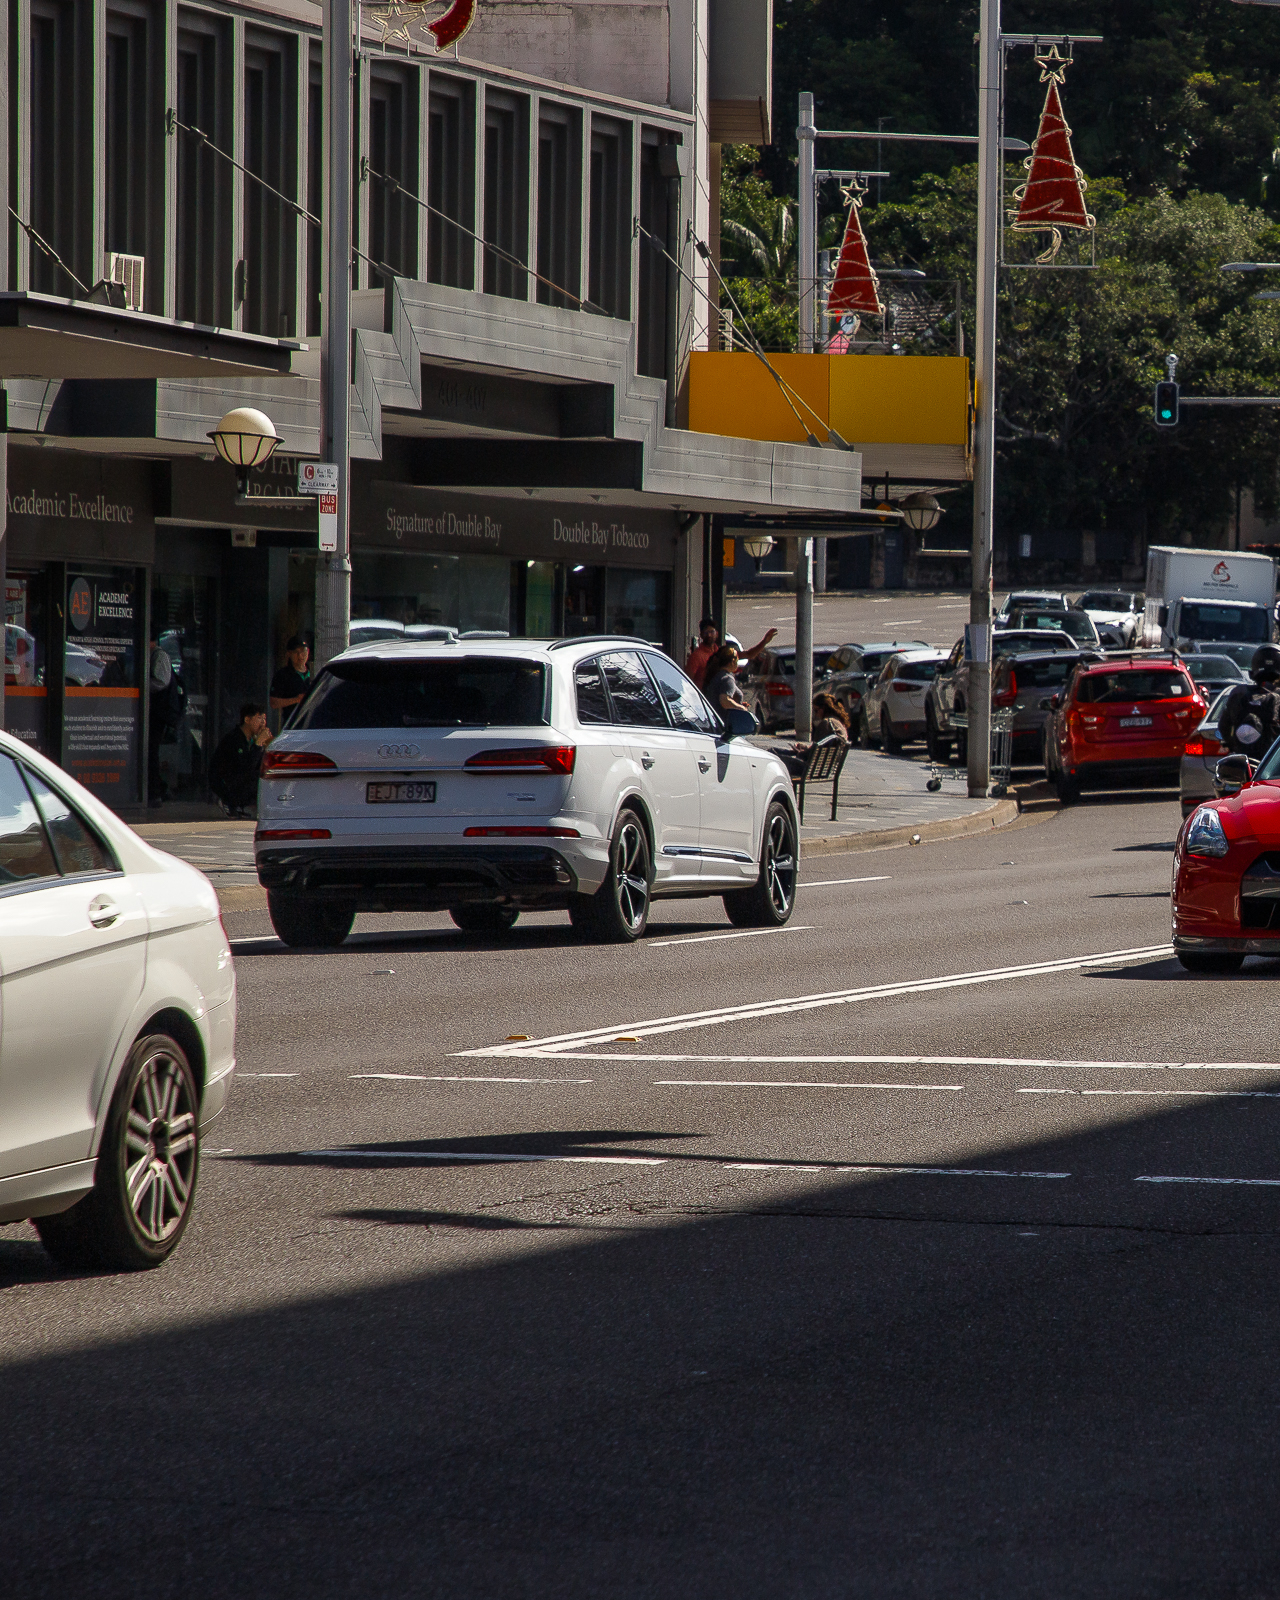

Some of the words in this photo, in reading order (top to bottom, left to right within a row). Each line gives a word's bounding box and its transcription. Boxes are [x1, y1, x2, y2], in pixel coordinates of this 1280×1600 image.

[69, 493, 134, 524] Excellence
[321, 495, 335, 504] BUS
[321, 505, 335, 513] ZONE
[386, 507, 434, 540] Signature
[435, 512, 447, 535] of
[447, 513, 482, 538] Double
[484, 516, 502, 546] Bay
[553, 518, 590, 545] Double
[591, 522, 609, 552] Bay
[611, 524, 650, 549] Tobacco
[71, 591, 89, 615] AE
[98, 592, 129, 605] ACADEMIC
[98, 605, 133, 619] EXCELLENCE
